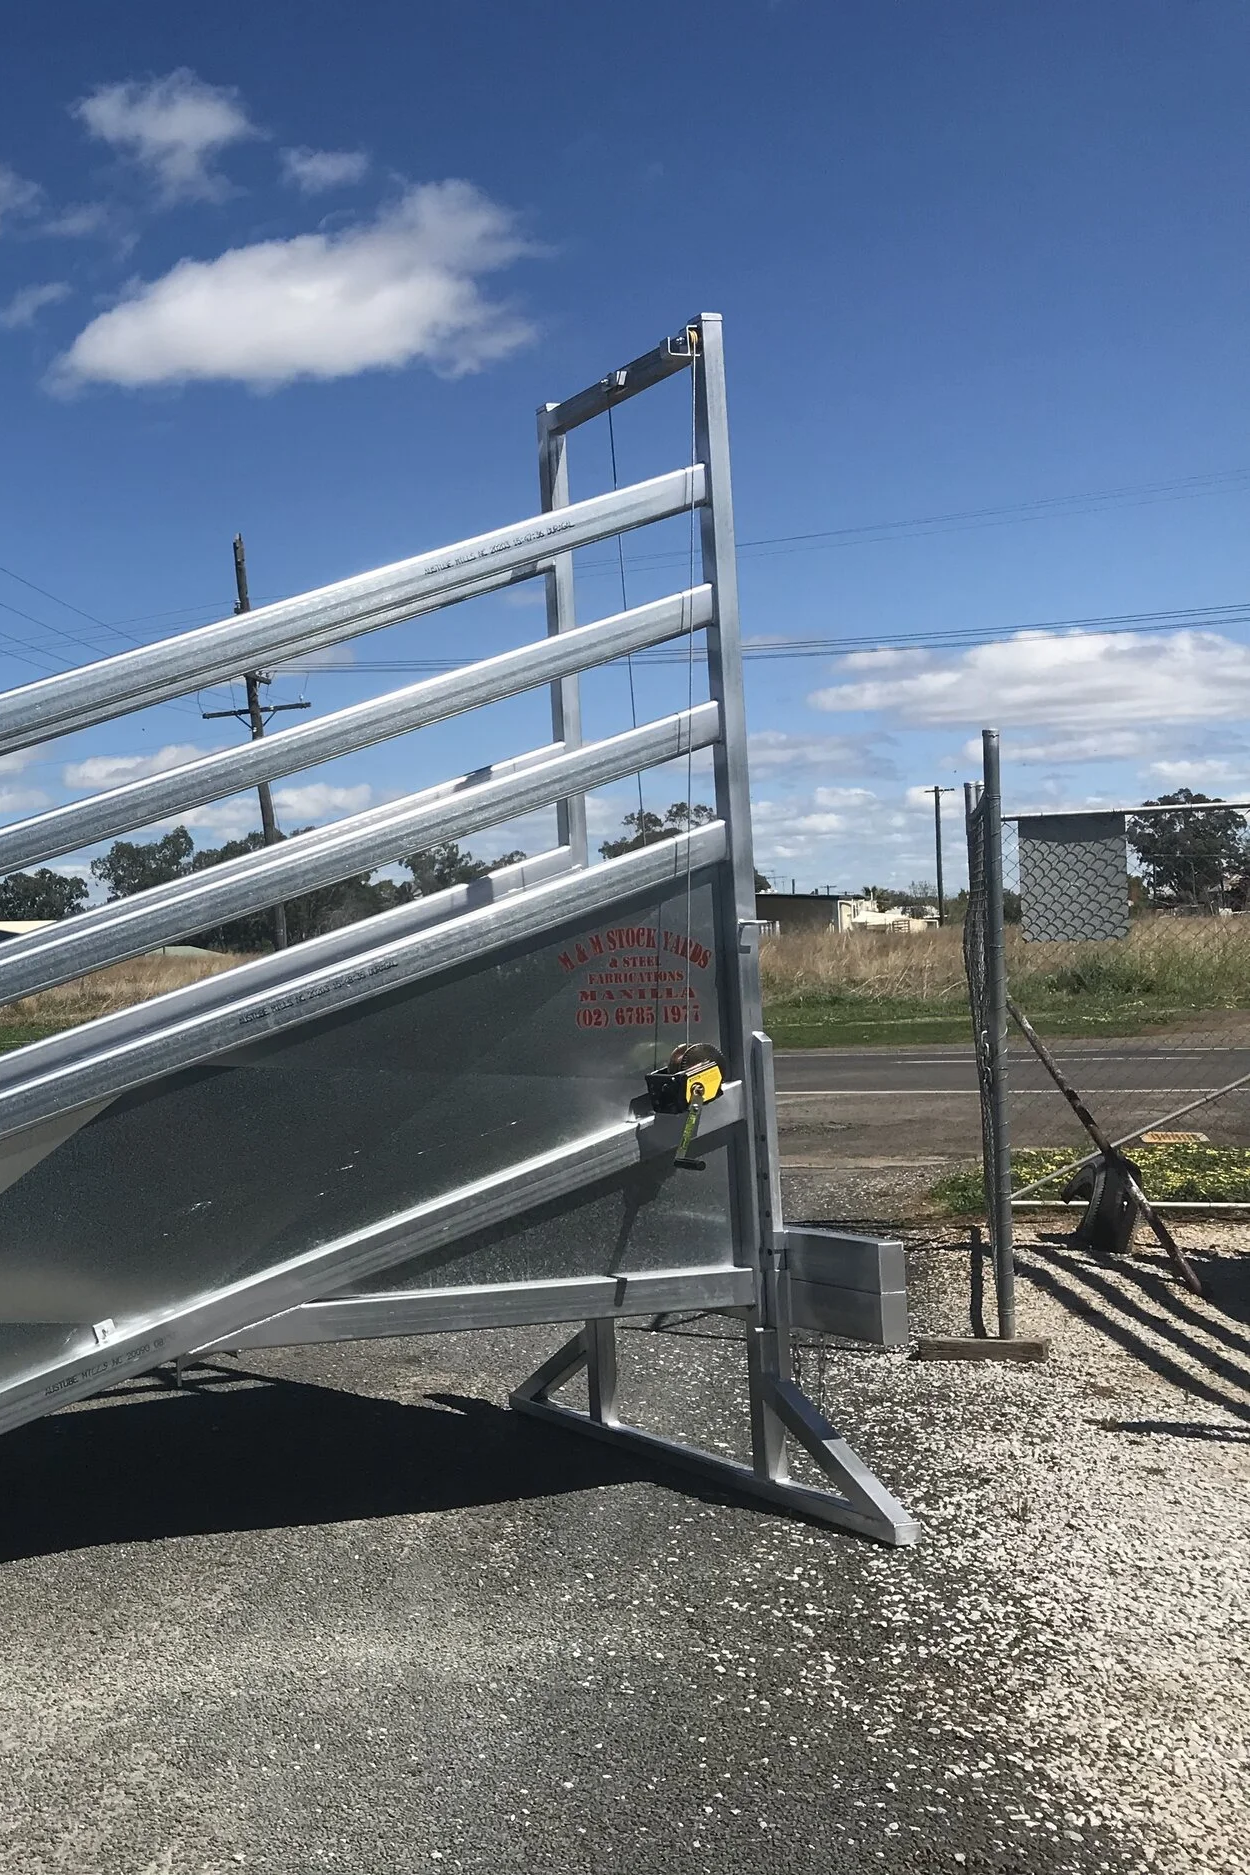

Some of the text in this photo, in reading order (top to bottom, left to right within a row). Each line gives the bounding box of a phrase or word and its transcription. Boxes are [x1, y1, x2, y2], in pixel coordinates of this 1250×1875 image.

[558, 927, 712, 973] M & M STOCK YARDS
[609, 956, 661, 968] & STEEL
[588, 971, 684, 984] FABRICATIONS
[579, 987, 695, 1002] MANILLA
[576, 1005, 700, 1028] (02) 6785 1977
